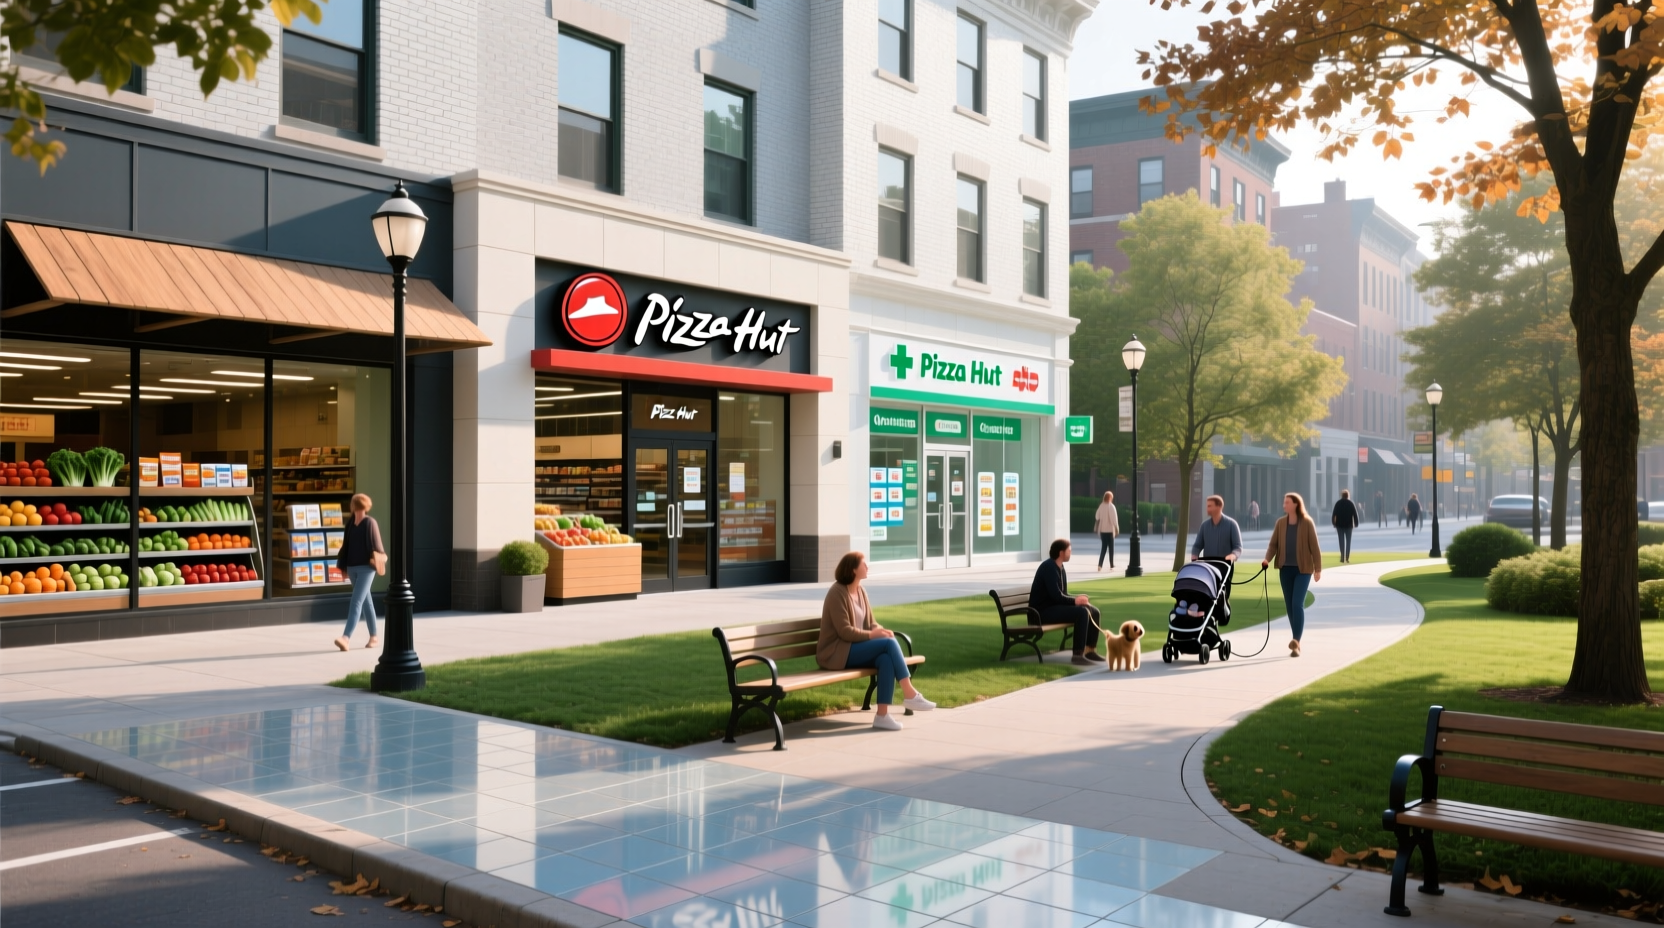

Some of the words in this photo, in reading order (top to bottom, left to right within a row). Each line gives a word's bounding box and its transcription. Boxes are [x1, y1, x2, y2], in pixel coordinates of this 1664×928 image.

[634, 292, 732, 347] Pizza
[733, 307, 800, 354] Hut
[920, 352, 967, 382] Pizza
[970, 360, 1003, 386] Hut
